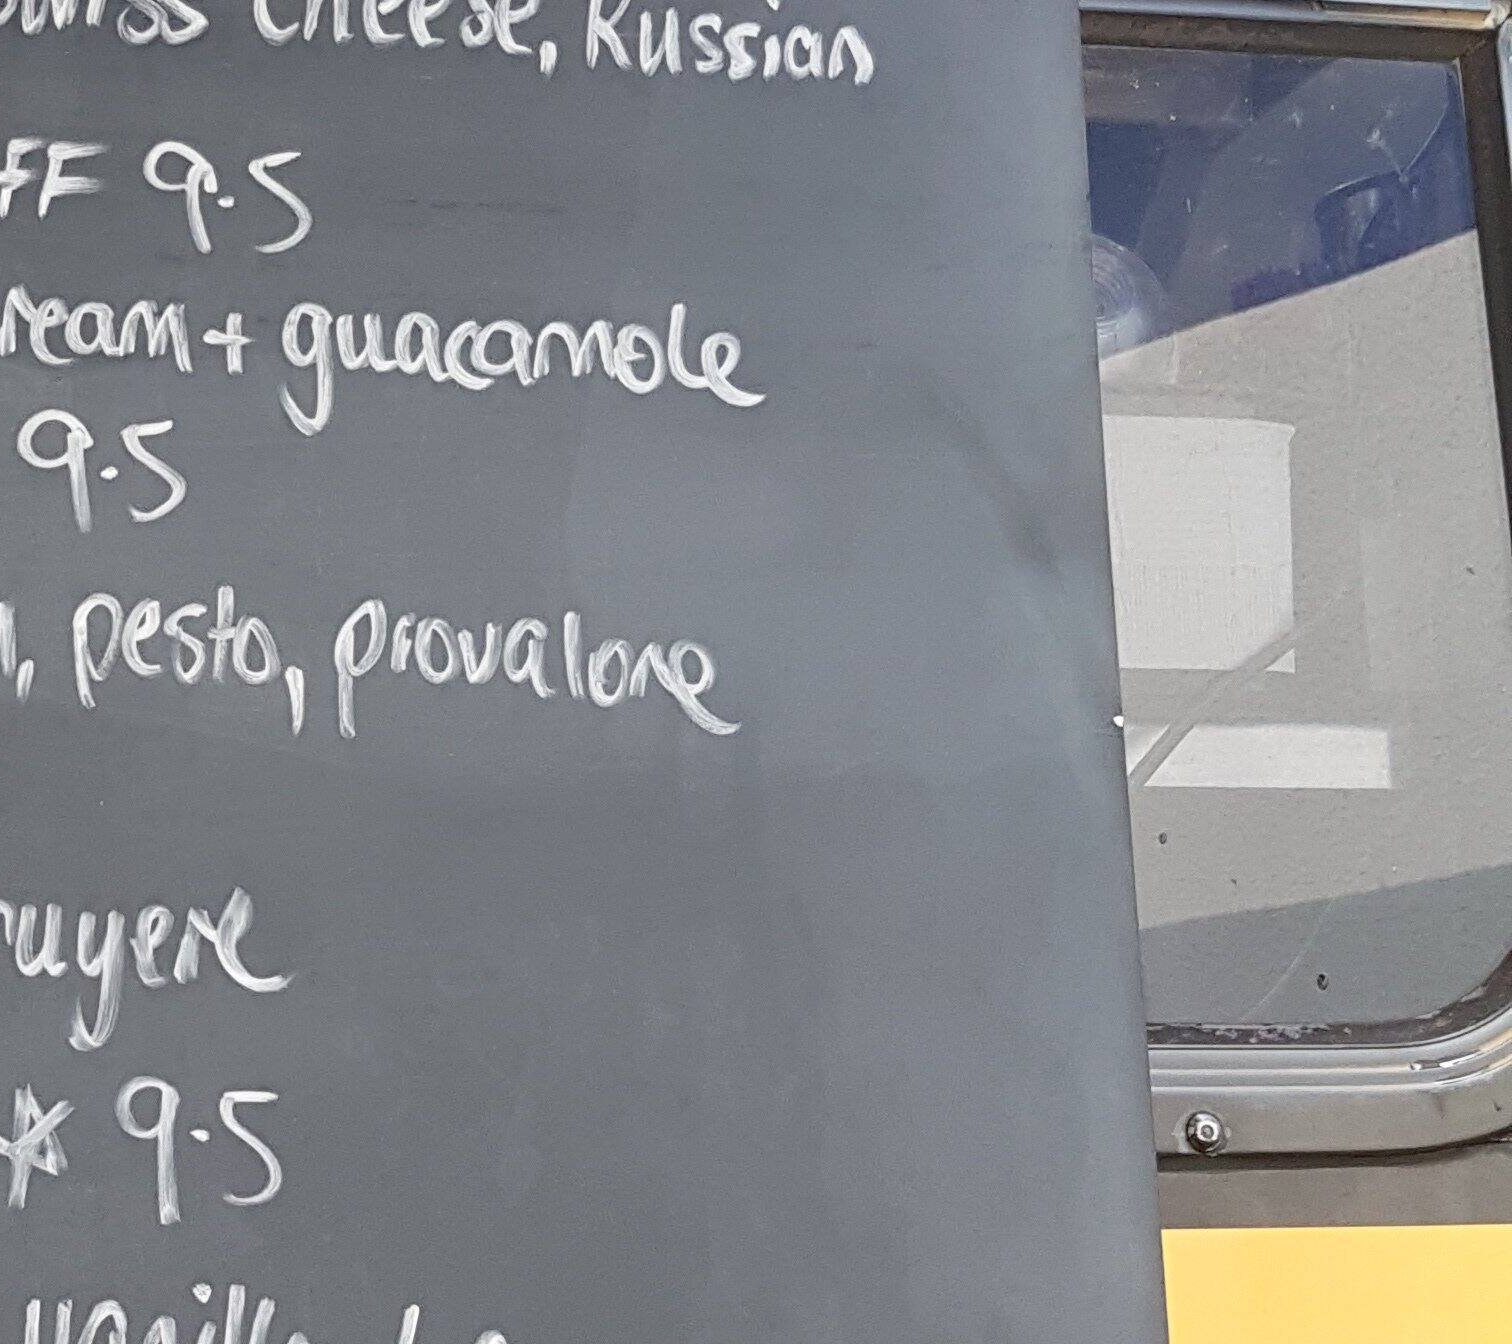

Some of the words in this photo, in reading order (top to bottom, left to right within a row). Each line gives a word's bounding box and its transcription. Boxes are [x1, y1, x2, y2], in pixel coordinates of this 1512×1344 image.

[141, 138, 314, 256] 9.5
[279, 300, 767, 438] guacamole
[15, 406, 188, 531] 9.5
[114, 1074, 284, 1227] 9.5
